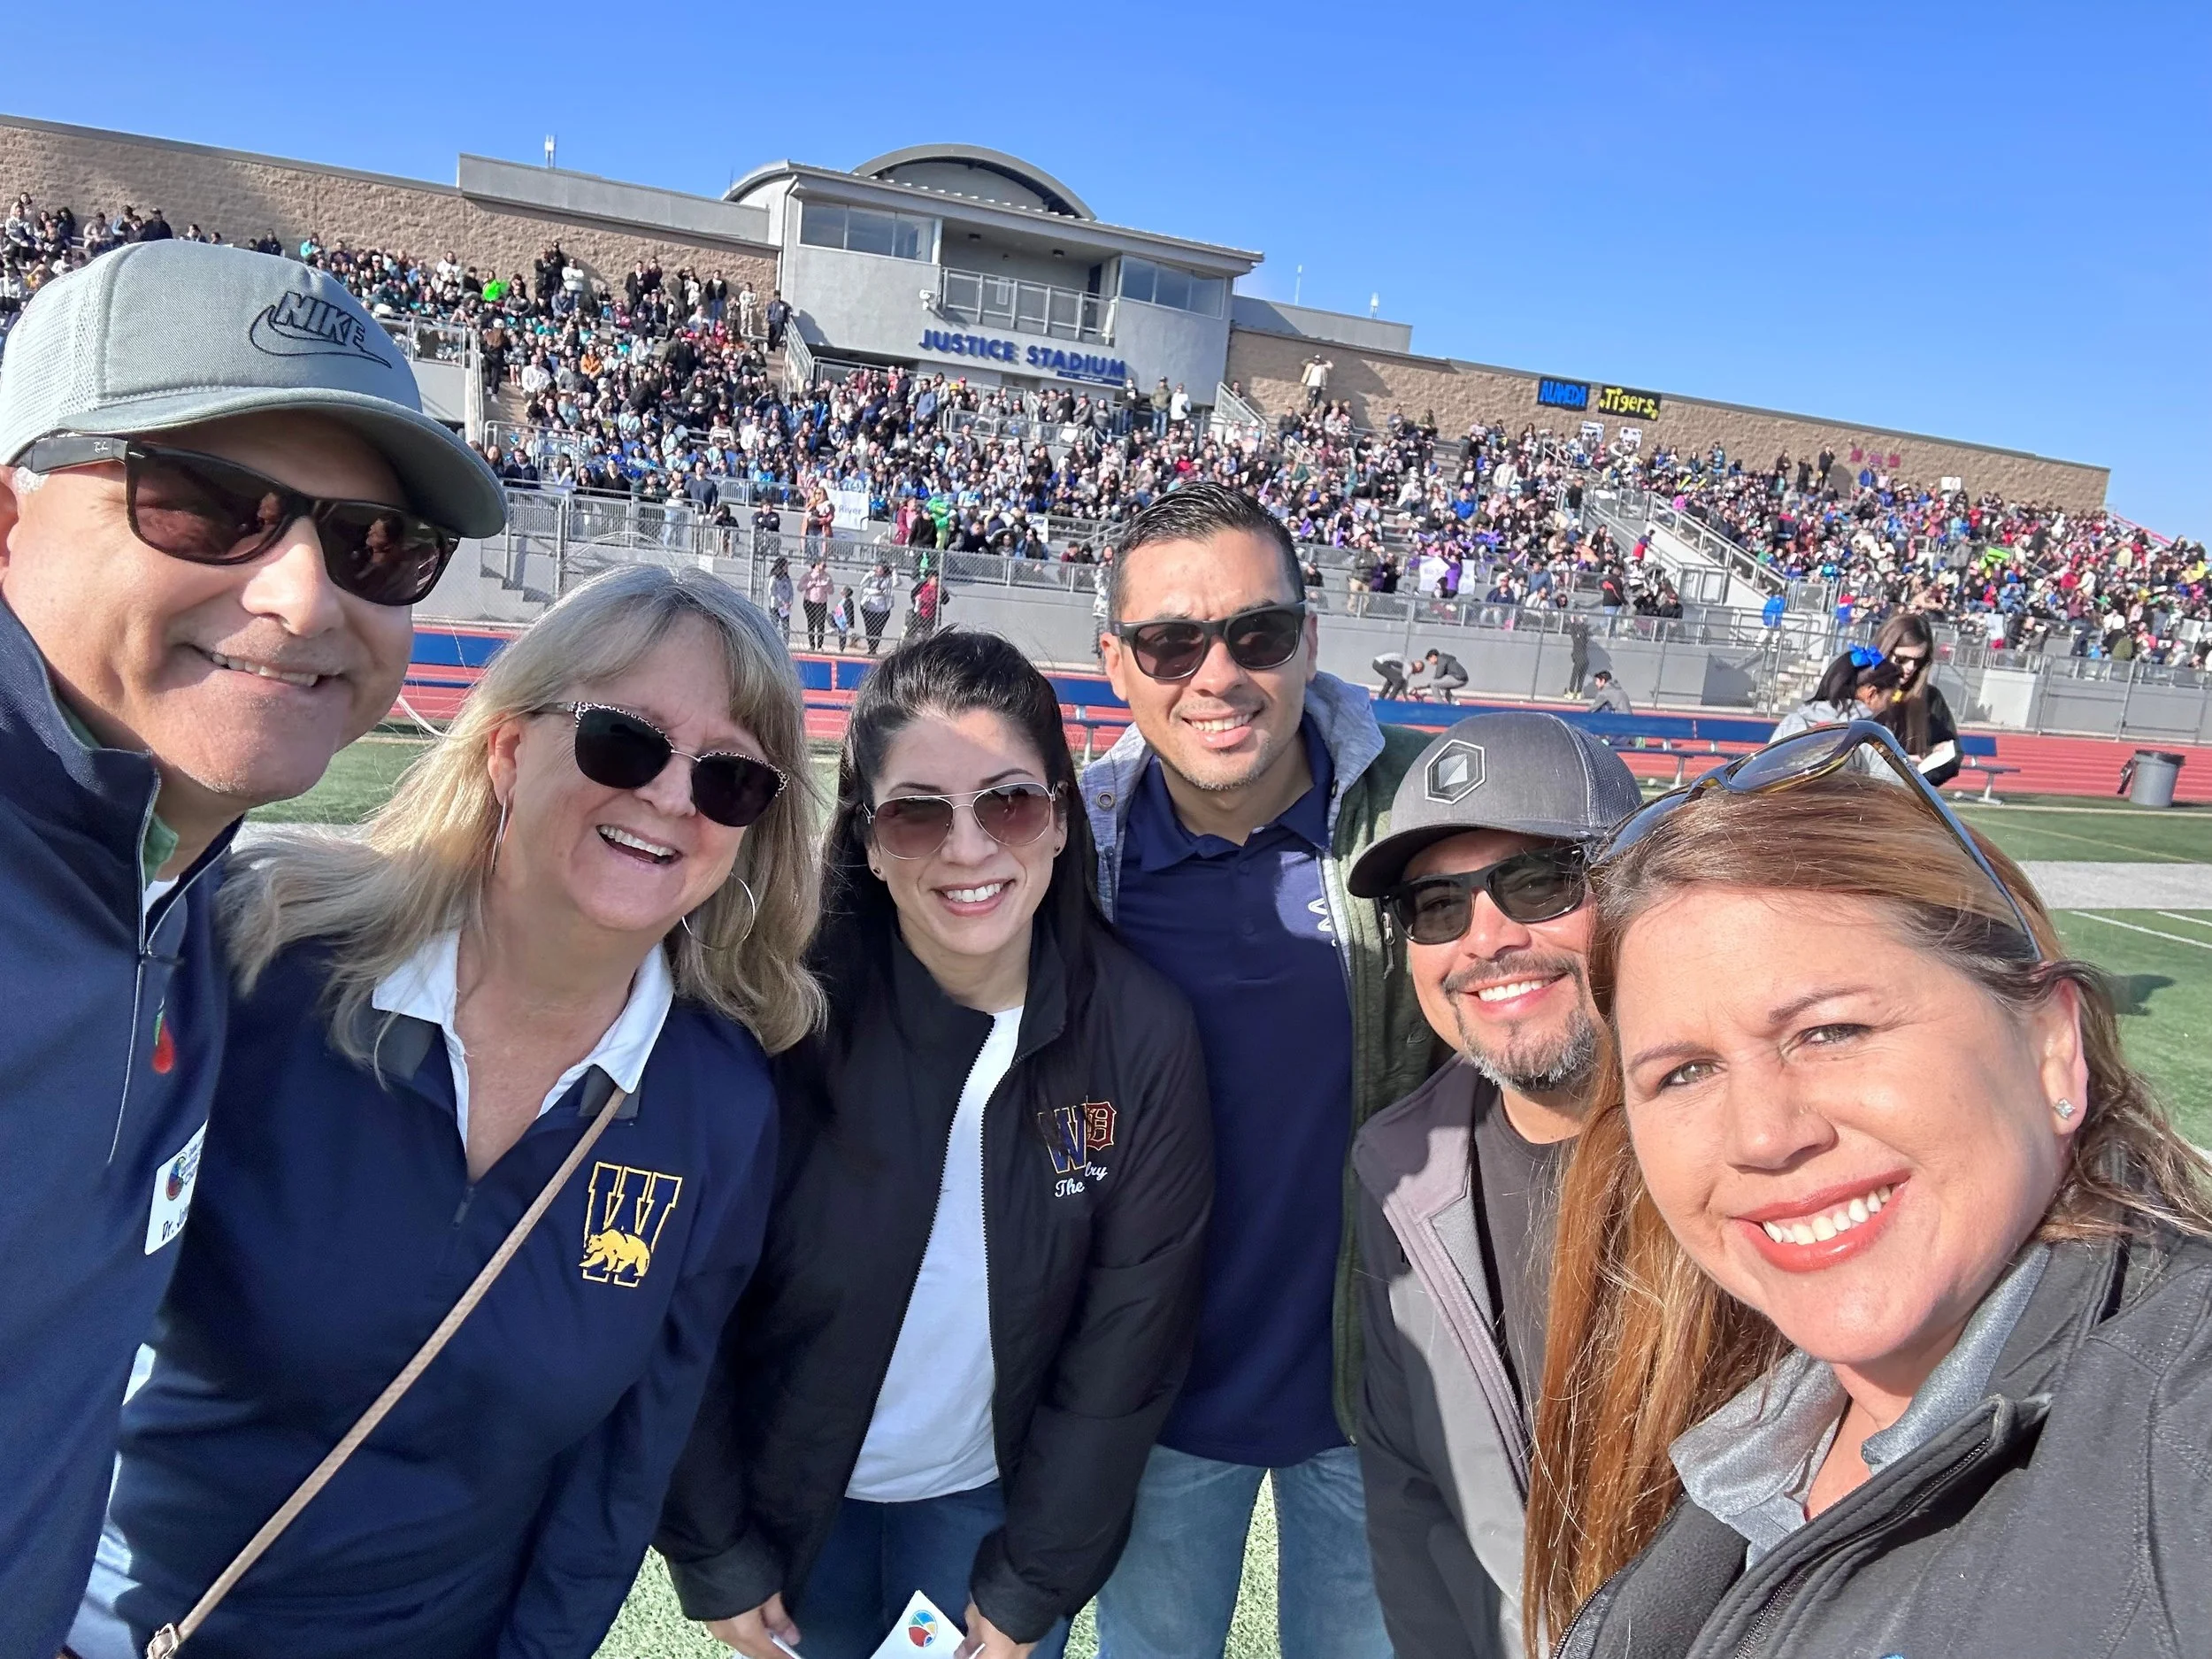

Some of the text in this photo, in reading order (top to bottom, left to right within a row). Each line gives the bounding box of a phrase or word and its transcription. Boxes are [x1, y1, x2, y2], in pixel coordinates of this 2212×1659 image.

[273, 290, 365, 349] NIKE
[918, 329, 1126, 379] JUSTICE STADIUM
[1604, 388, 1655, 413] Tigers
[1055, 1178, 1085, 1197] The
